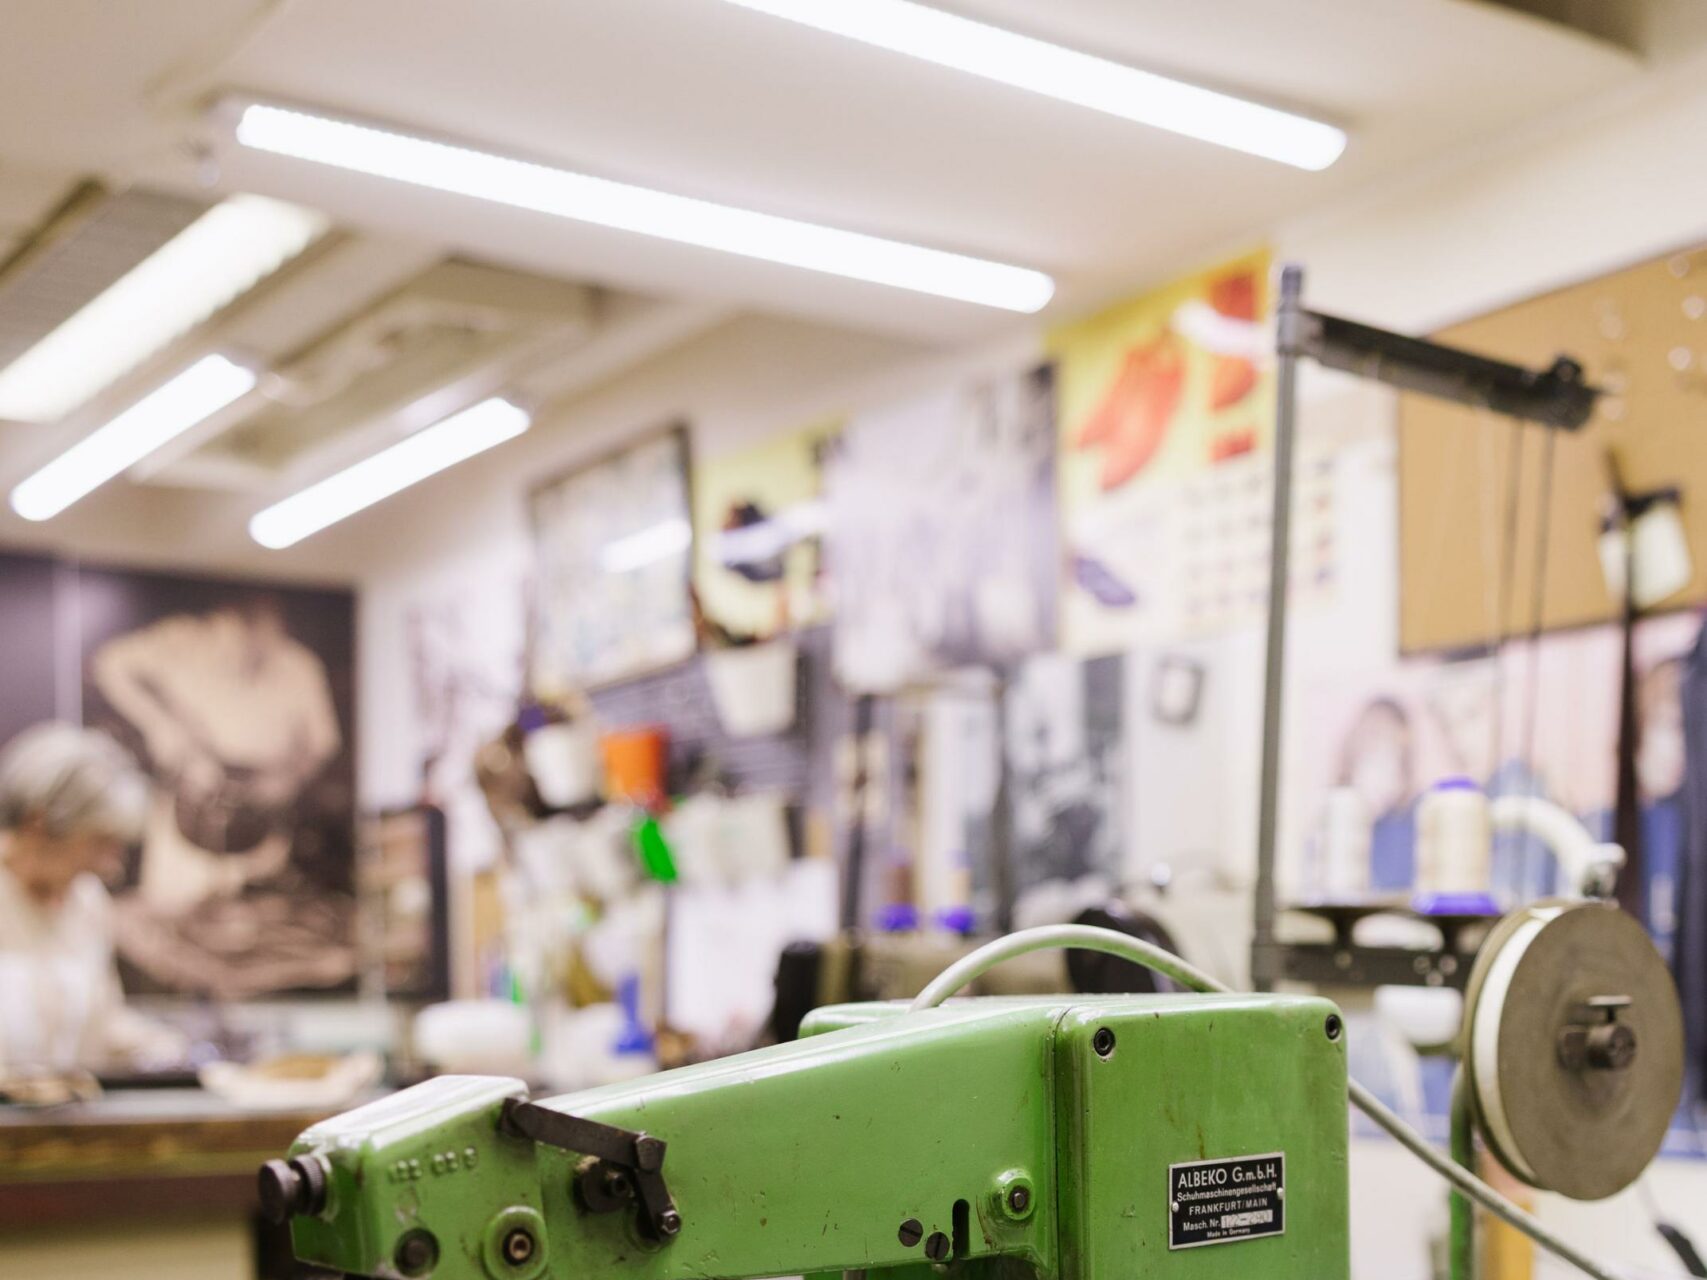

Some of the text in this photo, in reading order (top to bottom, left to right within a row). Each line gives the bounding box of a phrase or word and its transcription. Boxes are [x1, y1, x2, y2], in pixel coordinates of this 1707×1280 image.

[1178, 1163, 1277, 1189] ALBEKO G.m.b.H.
[1177, 1182, 1277, 1202] Schuhmaschinengesellschaft
[1189, 1198, 1268, 1216] FRANKFURT/MAIN
[1183, 1221, 1208, 1231] Masch.
[1209, 1218, 1220, 1228] Nr.
[1229, 1227, 1250, 1236] Germany
